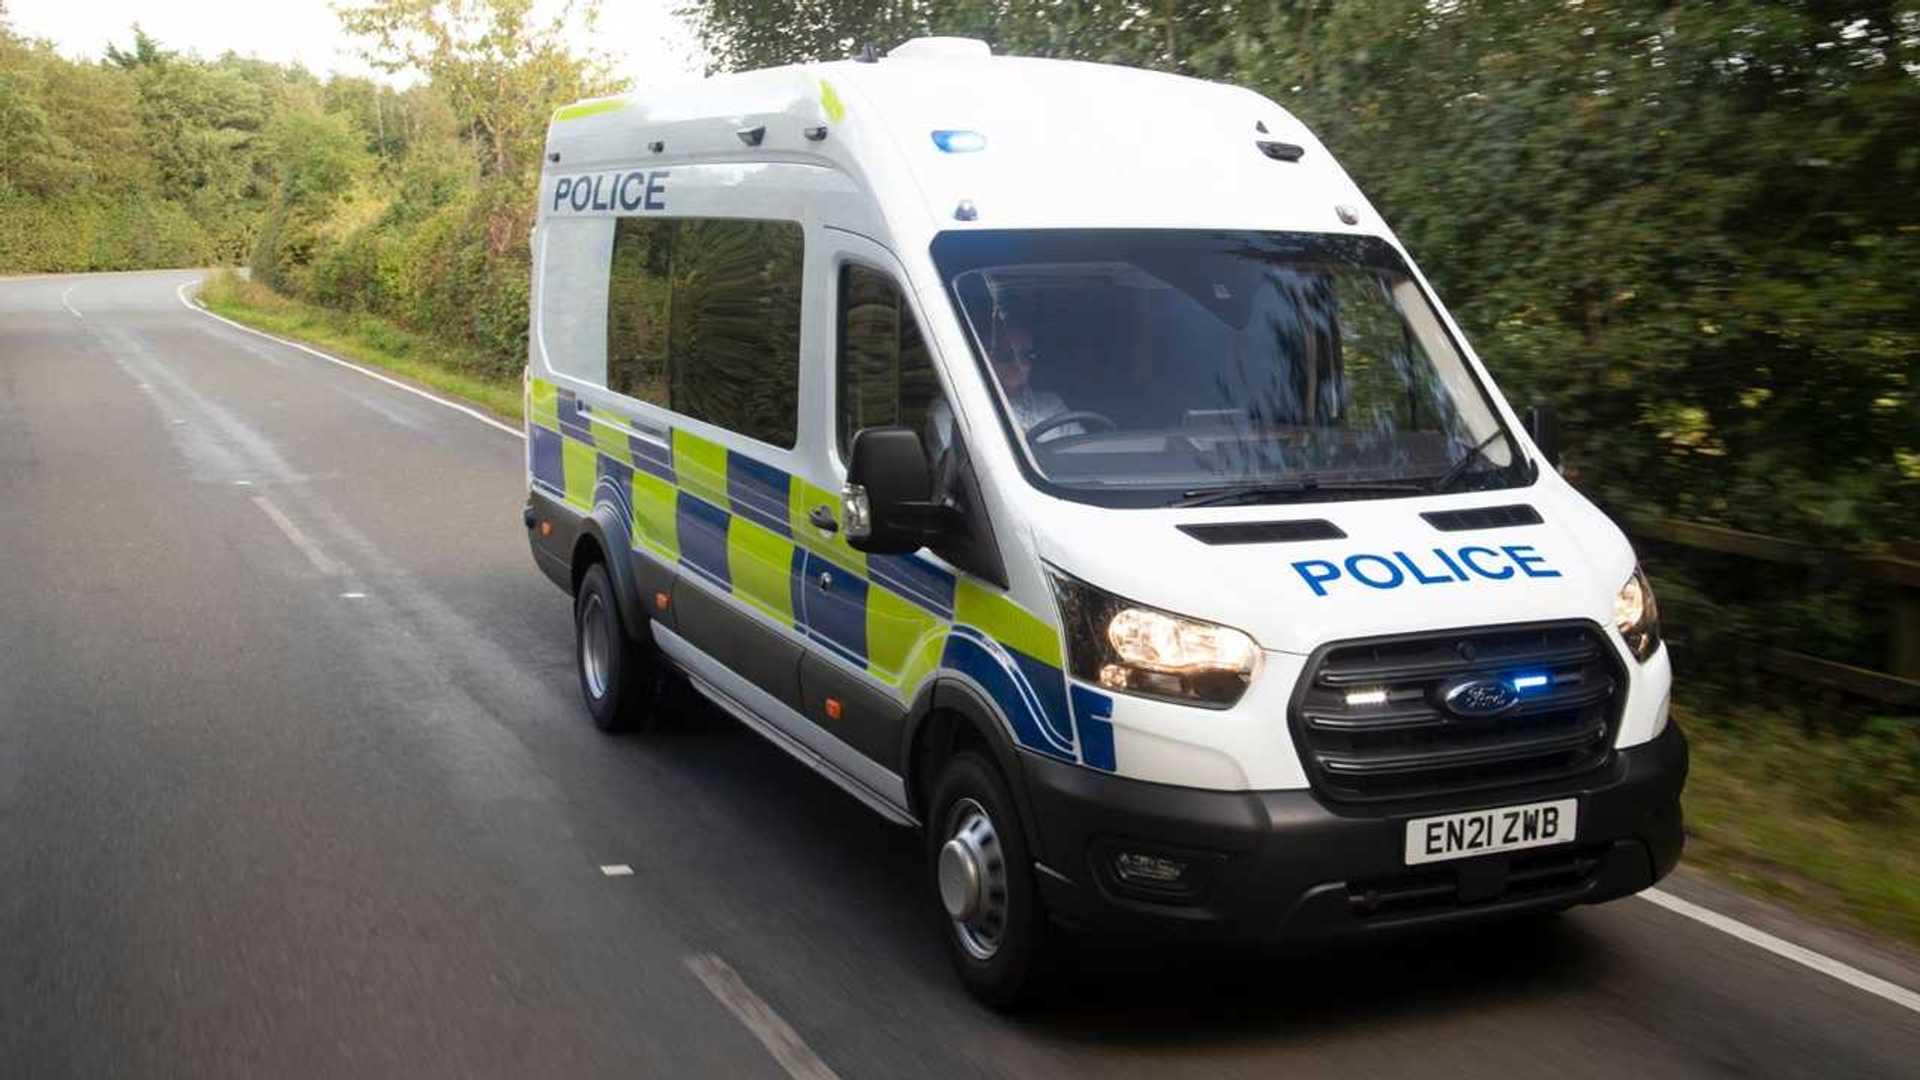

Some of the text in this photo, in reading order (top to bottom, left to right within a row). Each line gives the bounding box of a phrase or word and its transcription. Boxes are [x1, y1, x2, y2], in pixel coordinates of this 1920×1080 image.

[553, 171, 670, 211] POLICE
[1291, 545, 1562, 597] POLICE
[1466, 687, 1506, 708] Ford
[1425, 806, 1559, 855] EN21 ZWB
